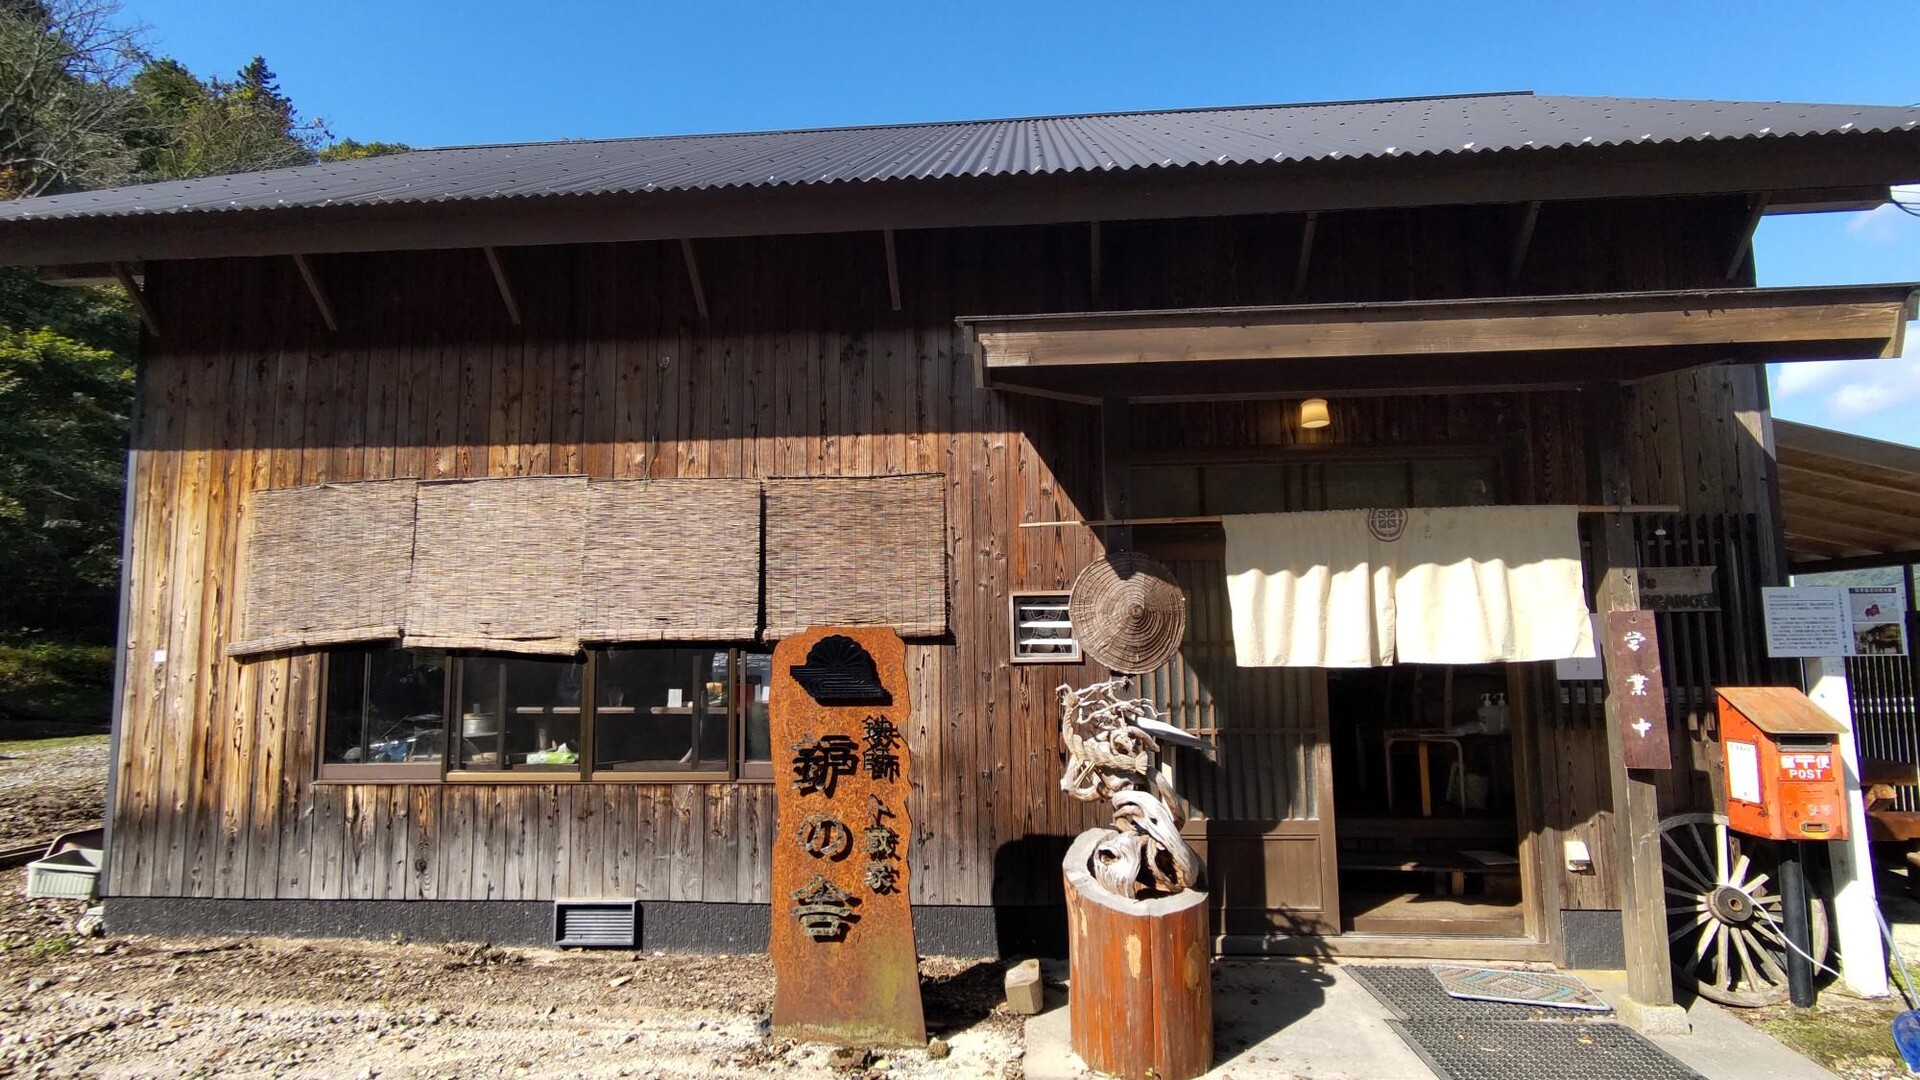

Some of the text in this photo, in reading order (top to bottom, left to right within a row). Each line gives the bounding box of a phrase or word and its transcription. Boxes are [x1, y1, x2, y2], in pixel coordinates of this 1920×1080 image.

[1624, 631, 1652, 738] 営業中
[1789, 769, 1823, 780] POST
